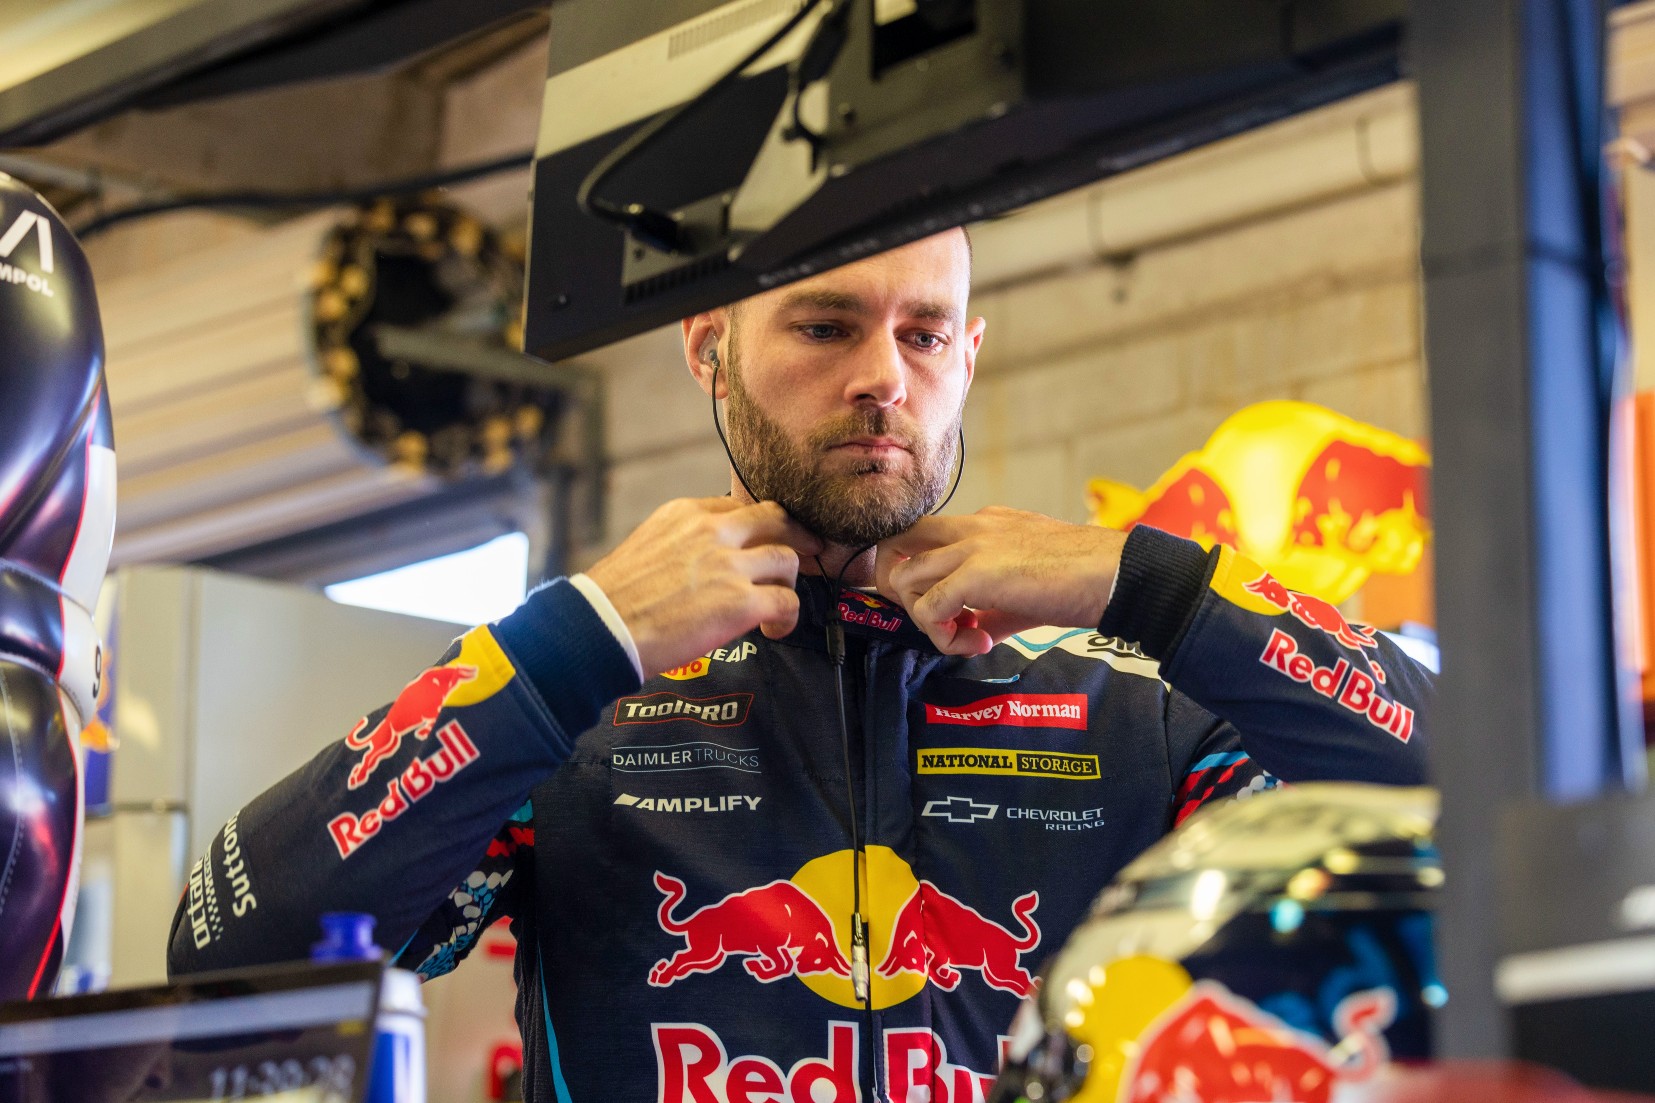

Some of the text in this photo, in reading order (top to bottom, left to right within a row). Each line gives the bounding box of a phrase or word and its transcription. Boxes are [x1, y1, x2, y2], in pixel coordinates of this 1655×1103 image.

[838, 602, 902, 632] Red Bull
[1259, 627, 1414, 745] Red Bull
[935, 701, 1081, 720] Harvey Norman
[613, 748, 759, 767] DAIMLER TRUCKS
[921, 754, 1093, 773] NATIONAL STORAGE
[327, 718, 481, 861] Red Bull
[635, 795, 762, 813] AMPLIFY
[1006, 807, 1104, 822] CHEVROLET
[1045, 819, 1105, 831] RACING
[650, 1019, 1014, 1103] Red Bu
